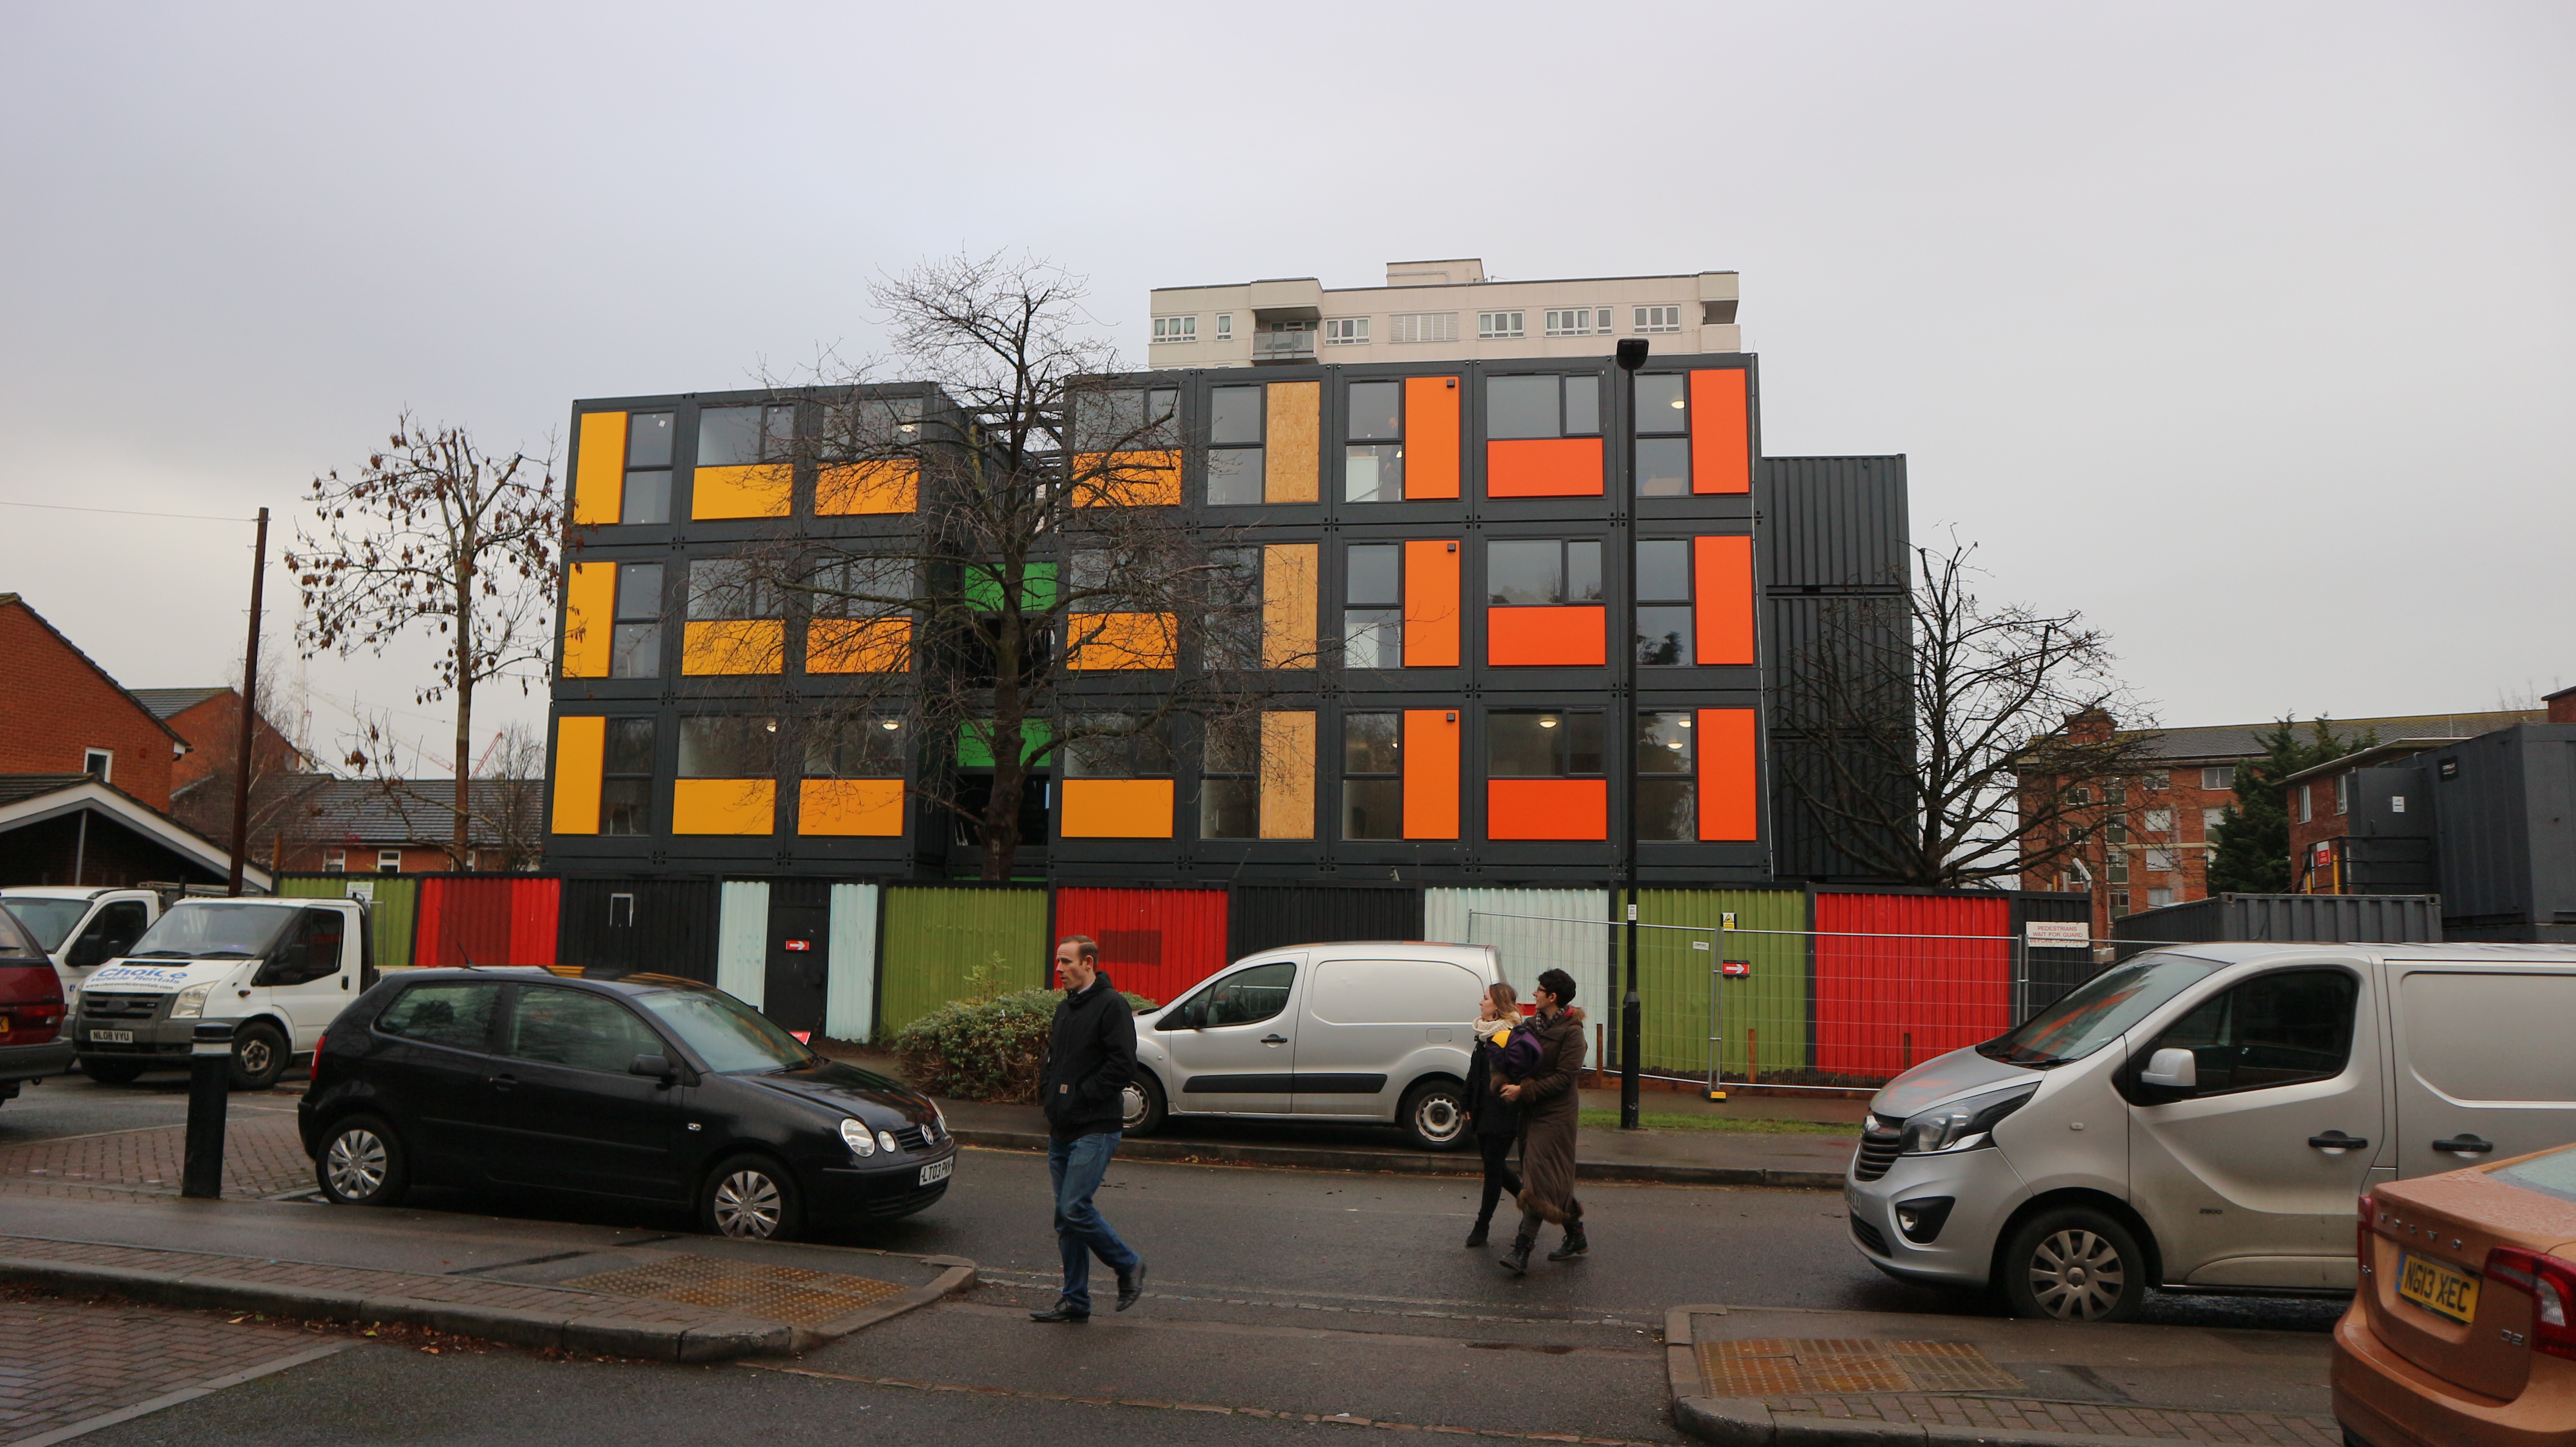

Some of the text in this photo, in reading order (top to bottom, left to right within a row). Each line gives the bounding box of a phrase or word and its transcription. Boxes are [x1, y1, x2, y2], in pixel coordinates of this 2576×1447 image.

[97, 967, 188, 978] Choice
[133, 975, 180, 984] Rentals
[93, 1031, 129, 1041] NL08 VYU
[2405, 1260, 2471, 1313] NG13 XEC
[2501, 1329, 2523, 1346] D2
